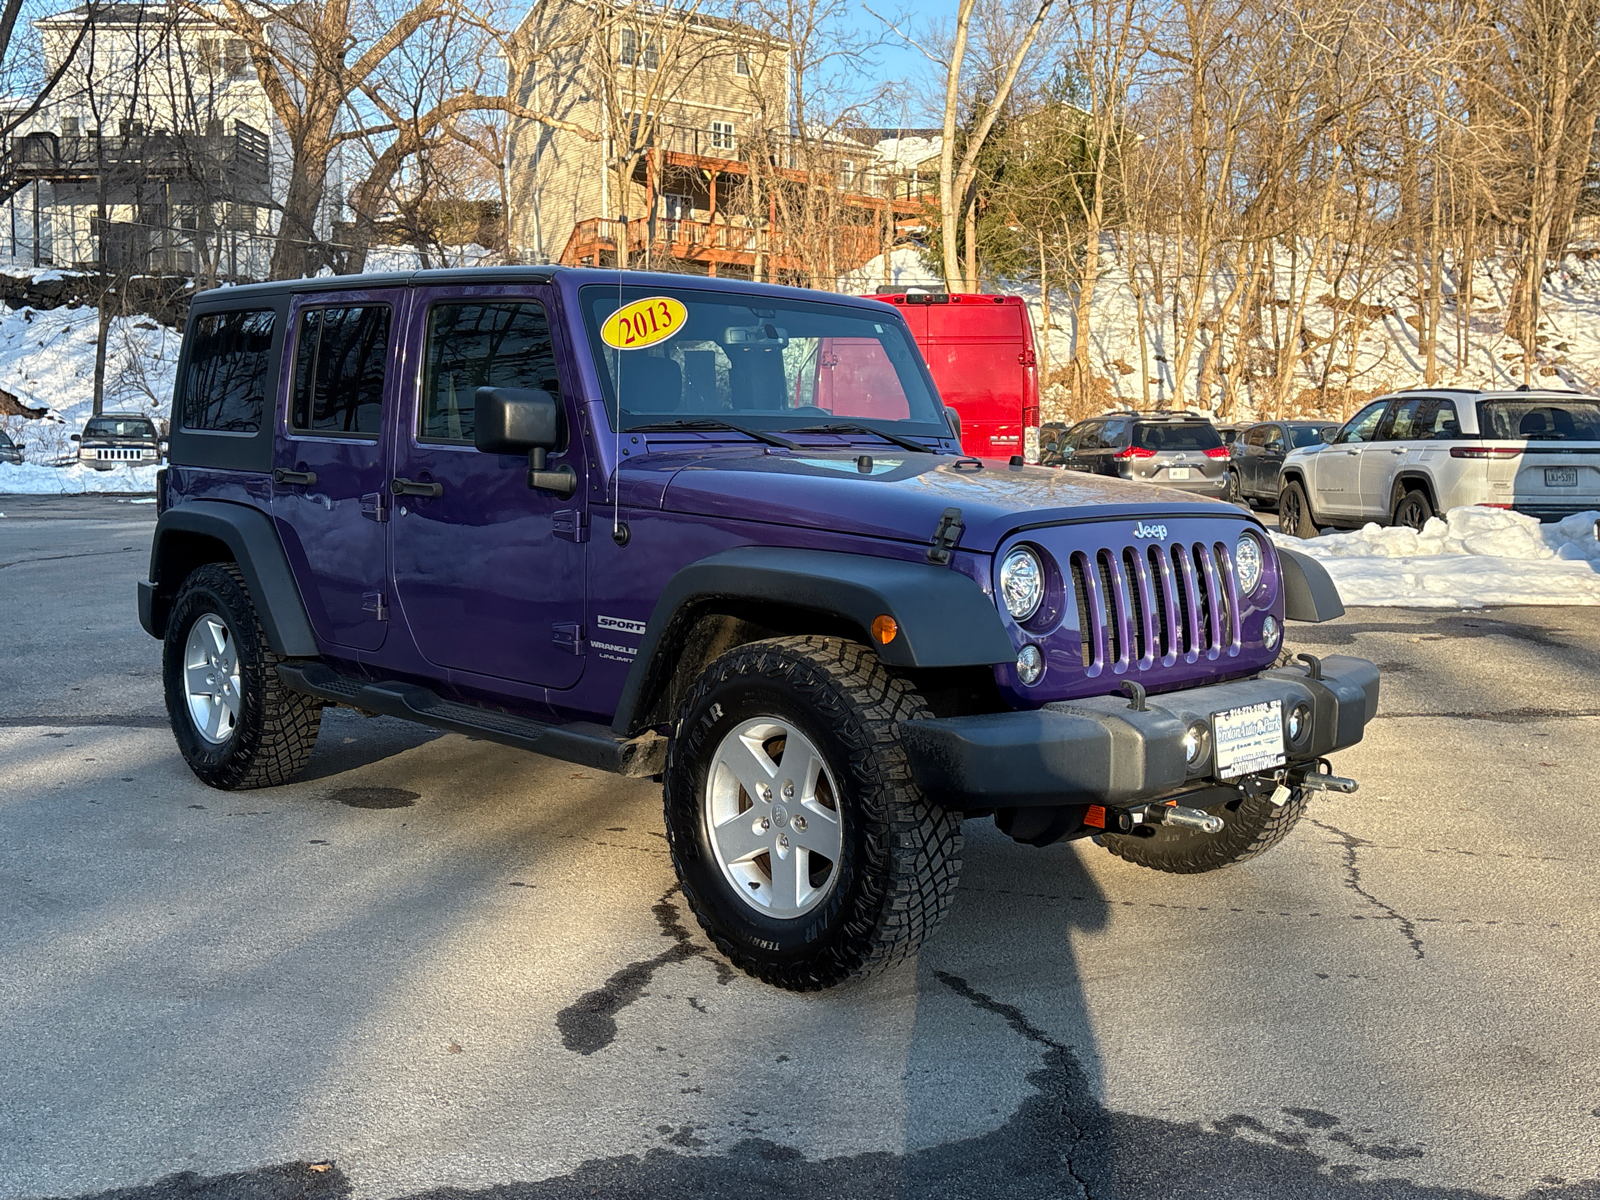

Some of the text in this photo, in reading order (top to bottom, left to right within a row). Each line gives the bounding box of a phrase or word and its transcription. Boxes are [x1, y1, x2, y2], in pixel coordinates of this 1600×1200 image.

[619, 301, 672, 345] 2013
[1132, 521, 1168, 541] Jeep
[600, 618, 646, 631] SPORT
[599, 653, 634, 664] UNLIMIT
